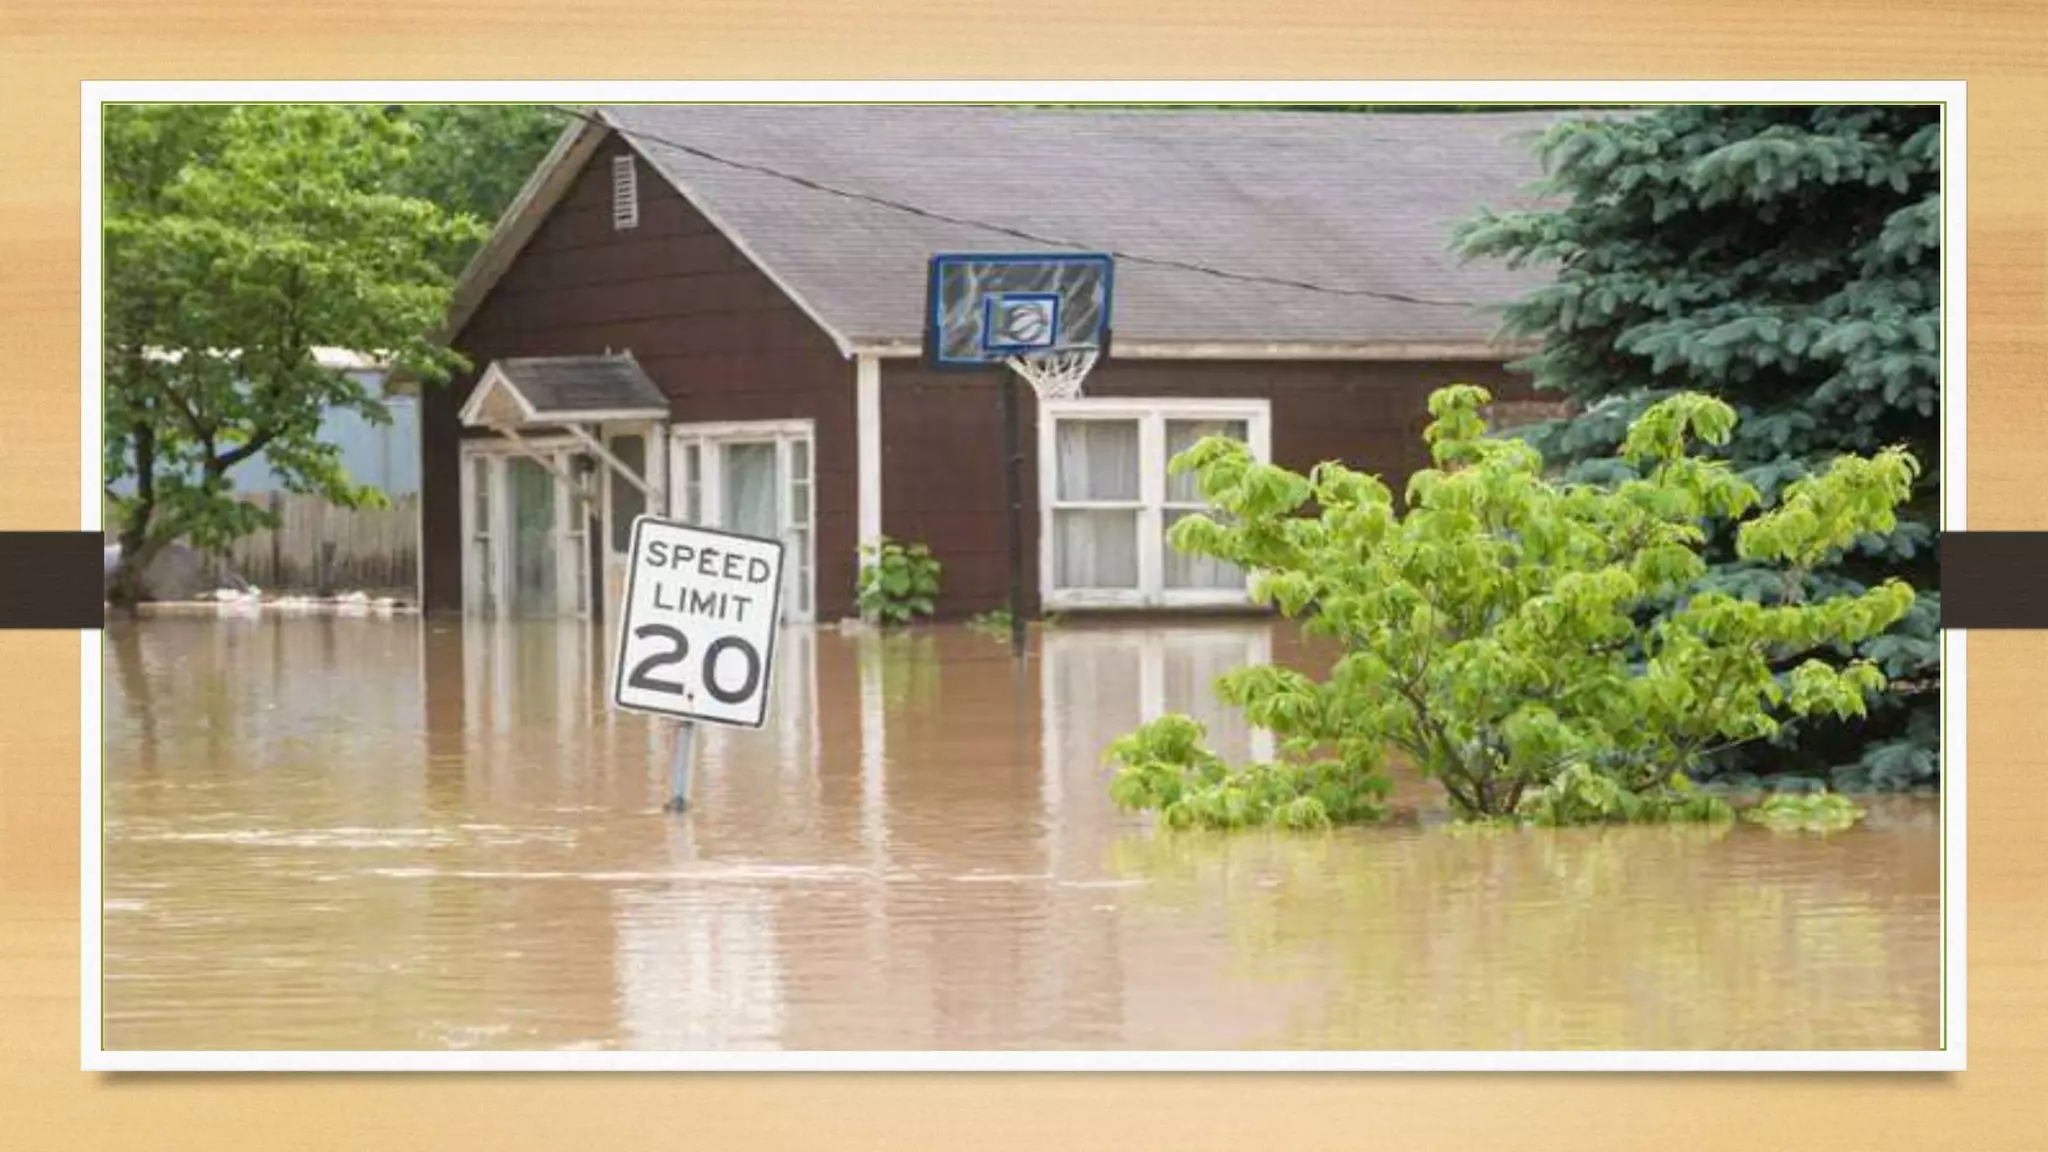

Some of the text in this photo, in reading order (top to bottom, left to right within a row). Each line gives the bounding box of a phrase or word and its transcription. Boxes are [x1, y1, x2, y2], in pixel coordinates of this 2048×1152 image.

[646, 540, 770, 584] SPEED
[653, 582, 752, 622] LIMIT
[628, 623, 761, 704] 20
